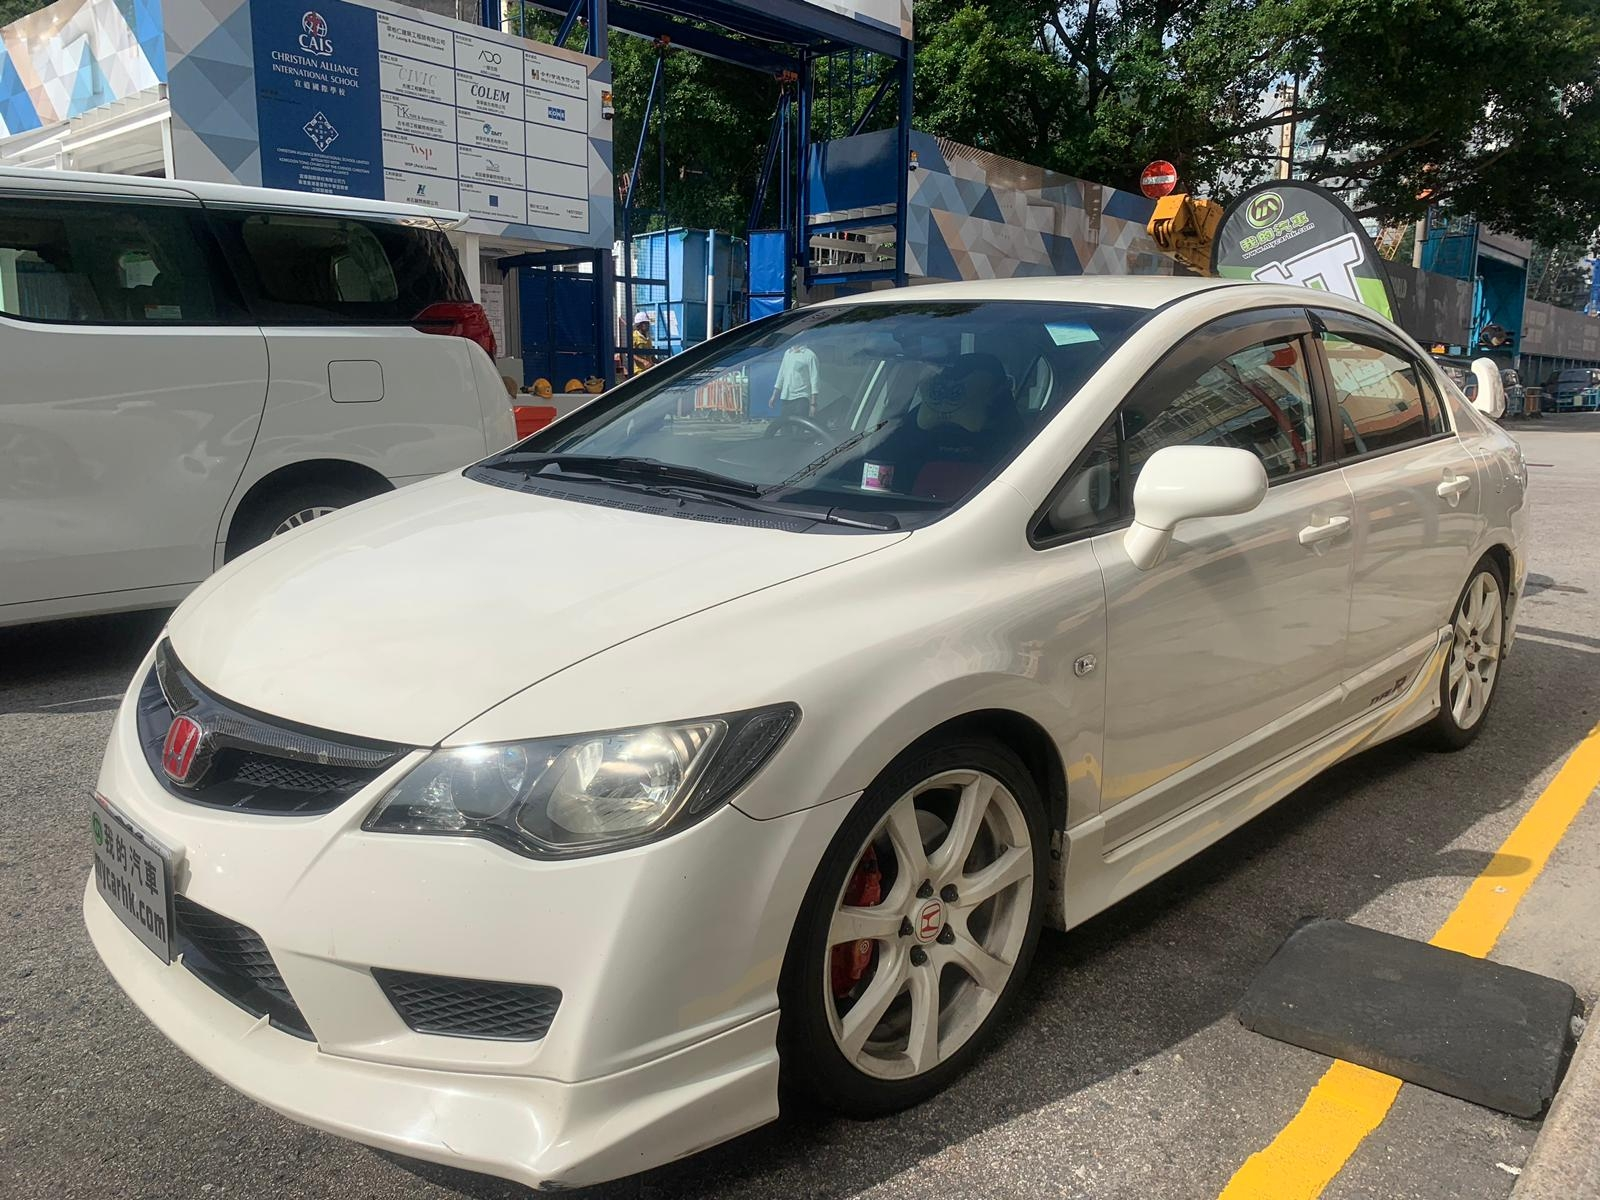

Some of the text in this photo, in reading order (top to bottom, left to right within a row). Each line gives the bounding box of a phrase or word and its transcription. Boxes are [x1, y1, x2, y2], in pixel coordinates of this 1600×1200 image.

[298, 34, 334, 53] CAIS
[271, 51, 359, 77] CHRISTIAN ALLIANCE
[272, 64, 360, 88] INTERNATIONAL SCHOOL
[399, 67, 438, 87] CIVIC
[470, 84, 510, 103] COLEM
[104, 823, 159, 896] 我的汽車
[95, 852, 166, 943] mycarhk.com
